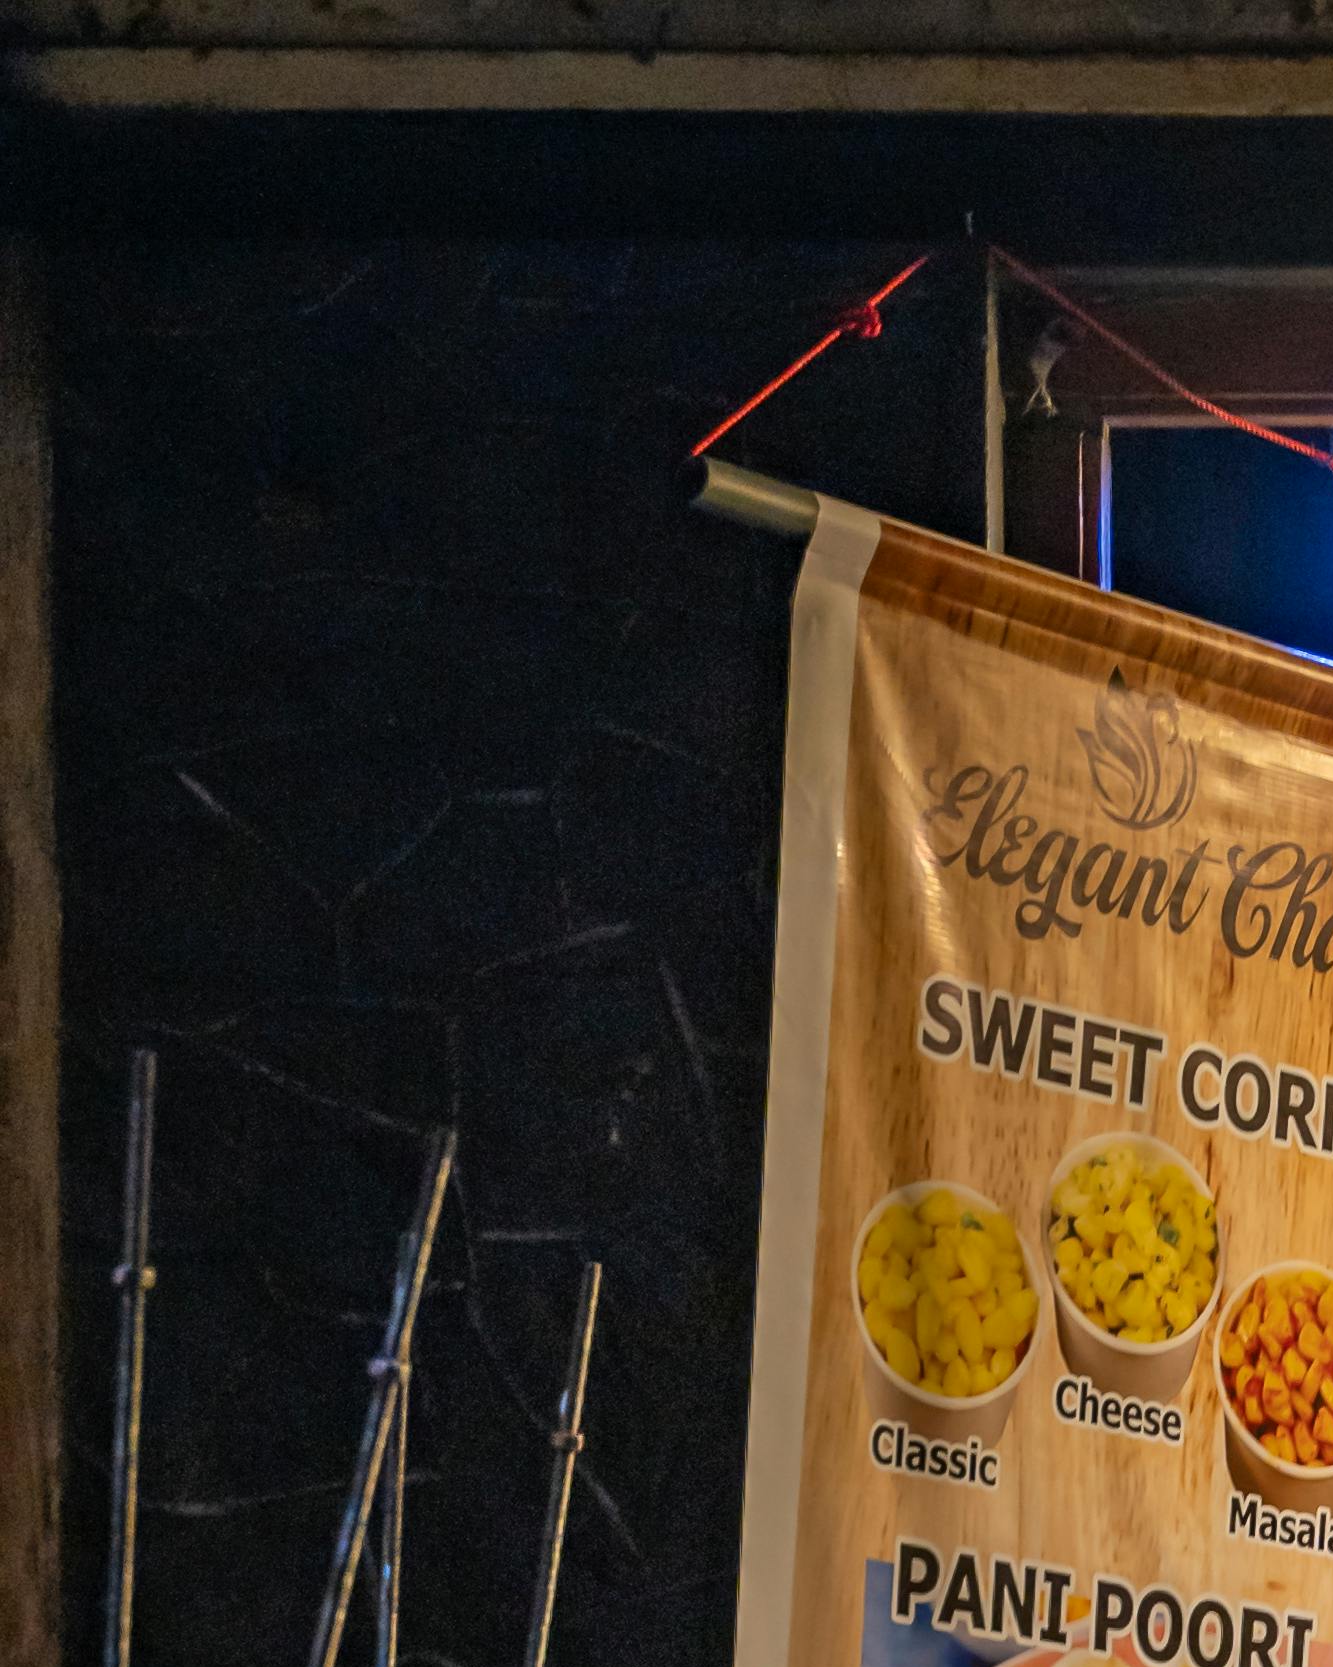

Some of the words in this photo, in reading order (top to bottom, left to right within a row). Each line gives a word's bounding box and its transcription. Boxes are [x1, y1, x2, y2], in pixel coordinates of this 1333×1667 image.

[923, 763, 1224, 940] Elegant
[921, 978, 1164, 1108] SWEET
[870, 1423, 998, 1486] Classic
[1055, 1379, 1182, 1441] Cheese
[893, 1543, 1072, 1644] PANI
